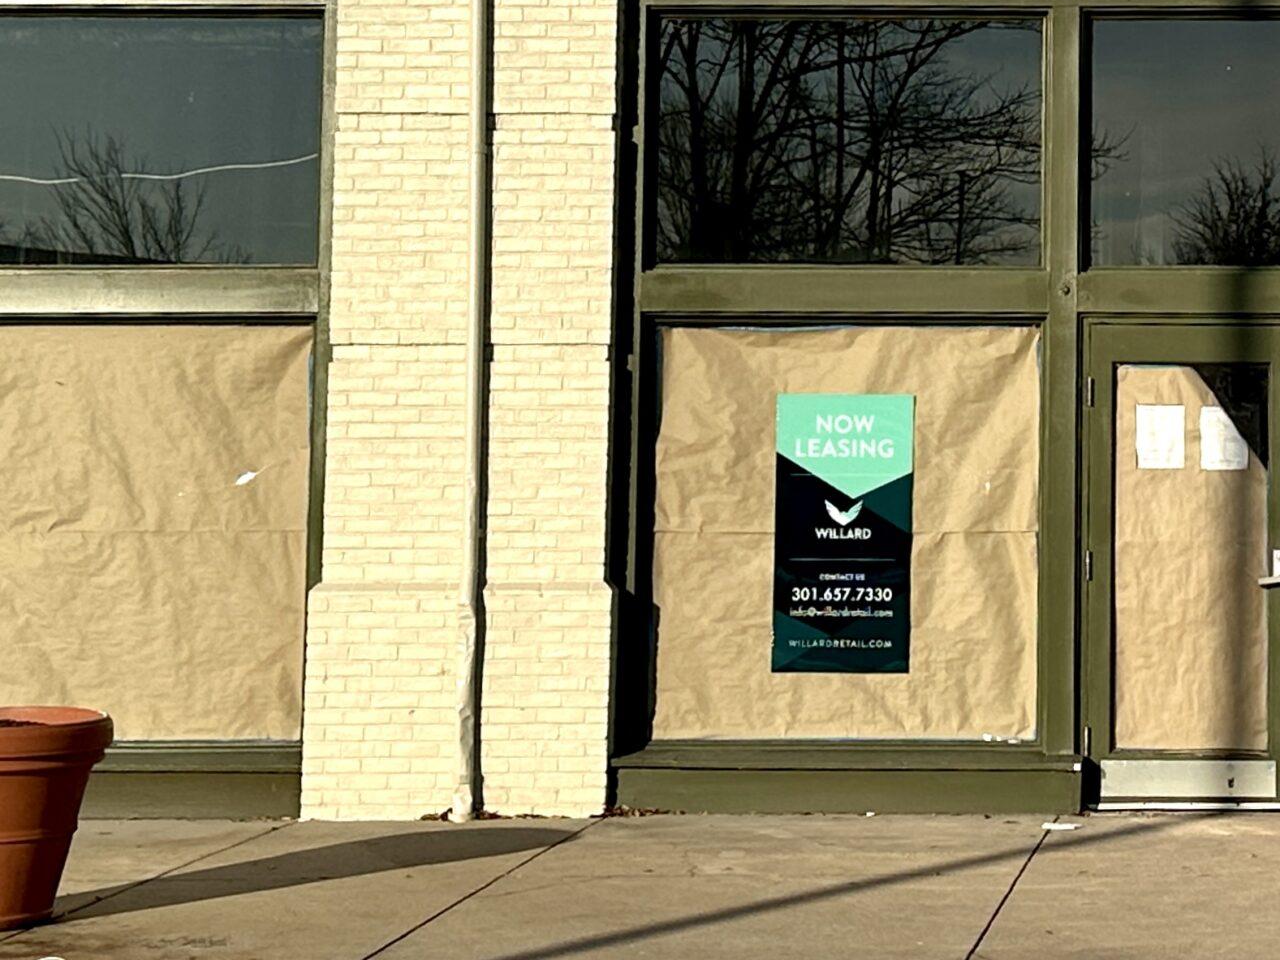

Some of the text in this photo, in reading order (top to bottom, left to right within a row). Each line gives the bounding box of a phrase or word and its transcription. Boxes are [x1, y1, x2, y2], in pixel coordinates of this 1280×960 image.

[815, 414, 875, 434] NOW
[794, 438, 895, 458] LEASING
[814, 527, 872, 540] WILLARD
[819, 573, 854, 581] CONTACT
[791, 586, 893, 602] 301.657.7330
[788, 639, 893, 649] WILLARDRETAIL.COM
